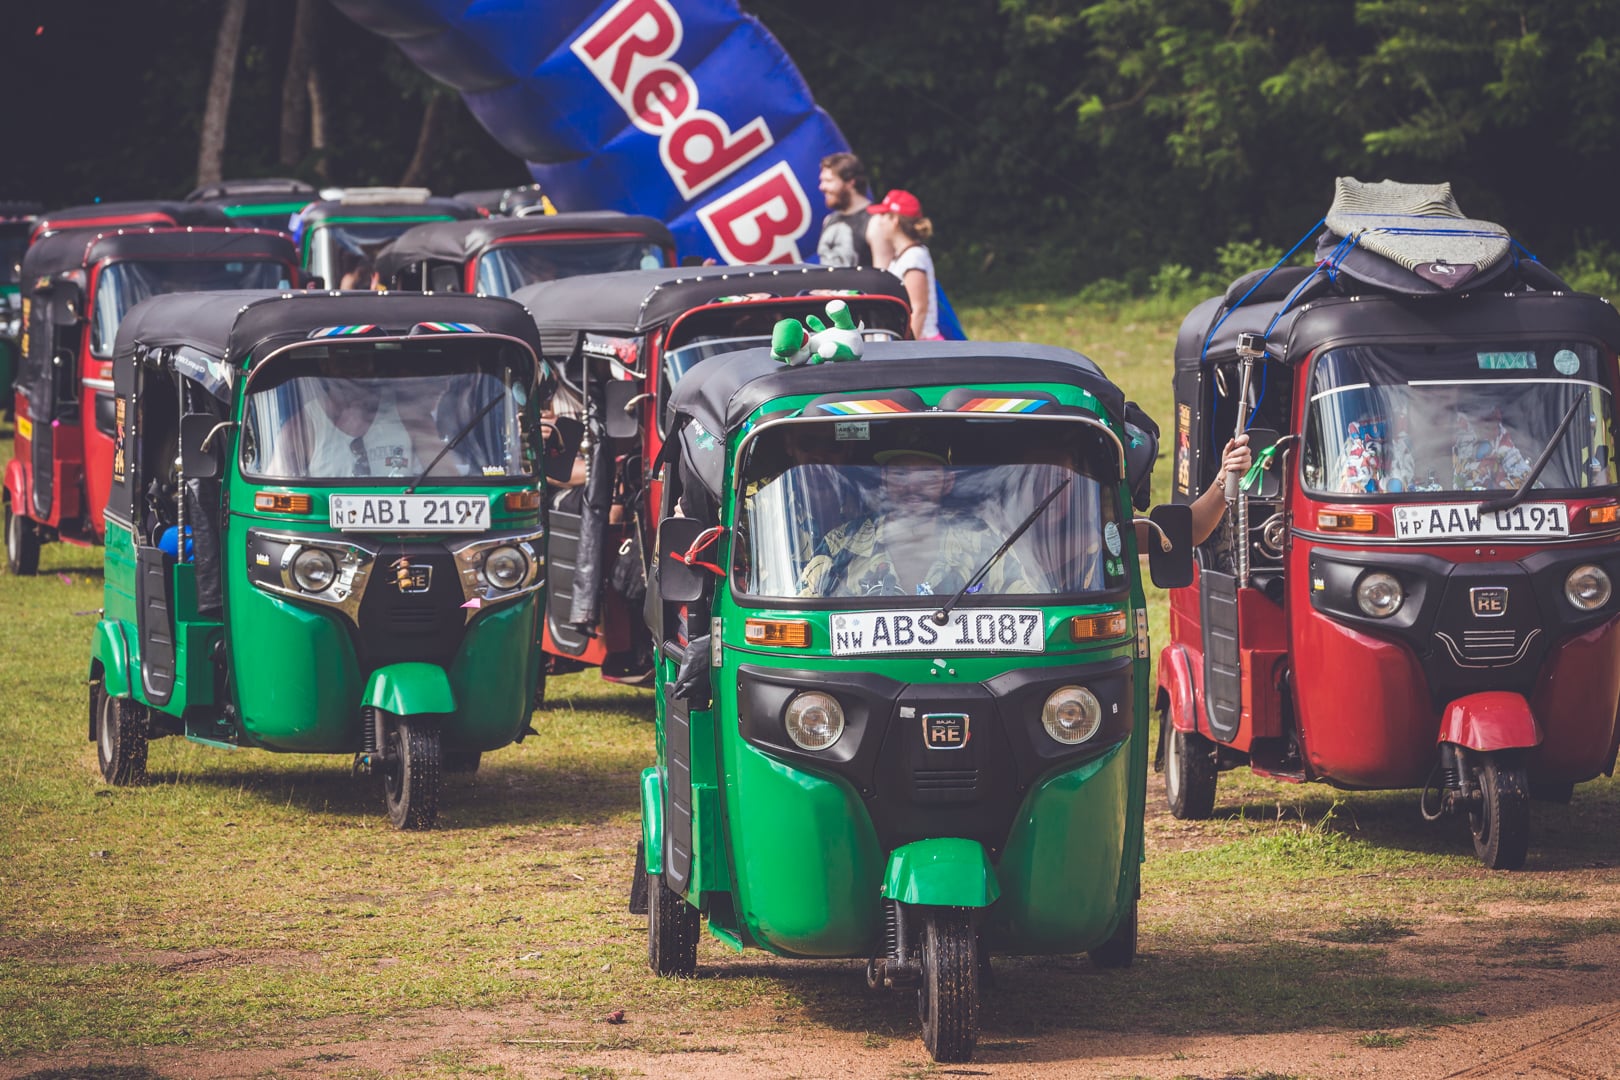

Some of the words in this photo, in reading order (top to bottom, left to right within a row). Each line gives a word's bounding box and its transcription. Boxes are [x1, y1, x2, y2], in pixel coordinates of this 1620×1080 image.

[577, 0, 768, 194] Red
[362, 500, 410, 524] ABI
[423, 500, 486, 525] 2197
[1400, 520, 1423, 535] WP
[1429, 508, 1482, 533] AAW
[1496, 507, 1565, 532] 0191
[836, 631, 863, 650] NW
[872, 615, 938, 647] ABS
[954, 614, 1038, 645] 1087
[931, 725, 961, 742] RE
